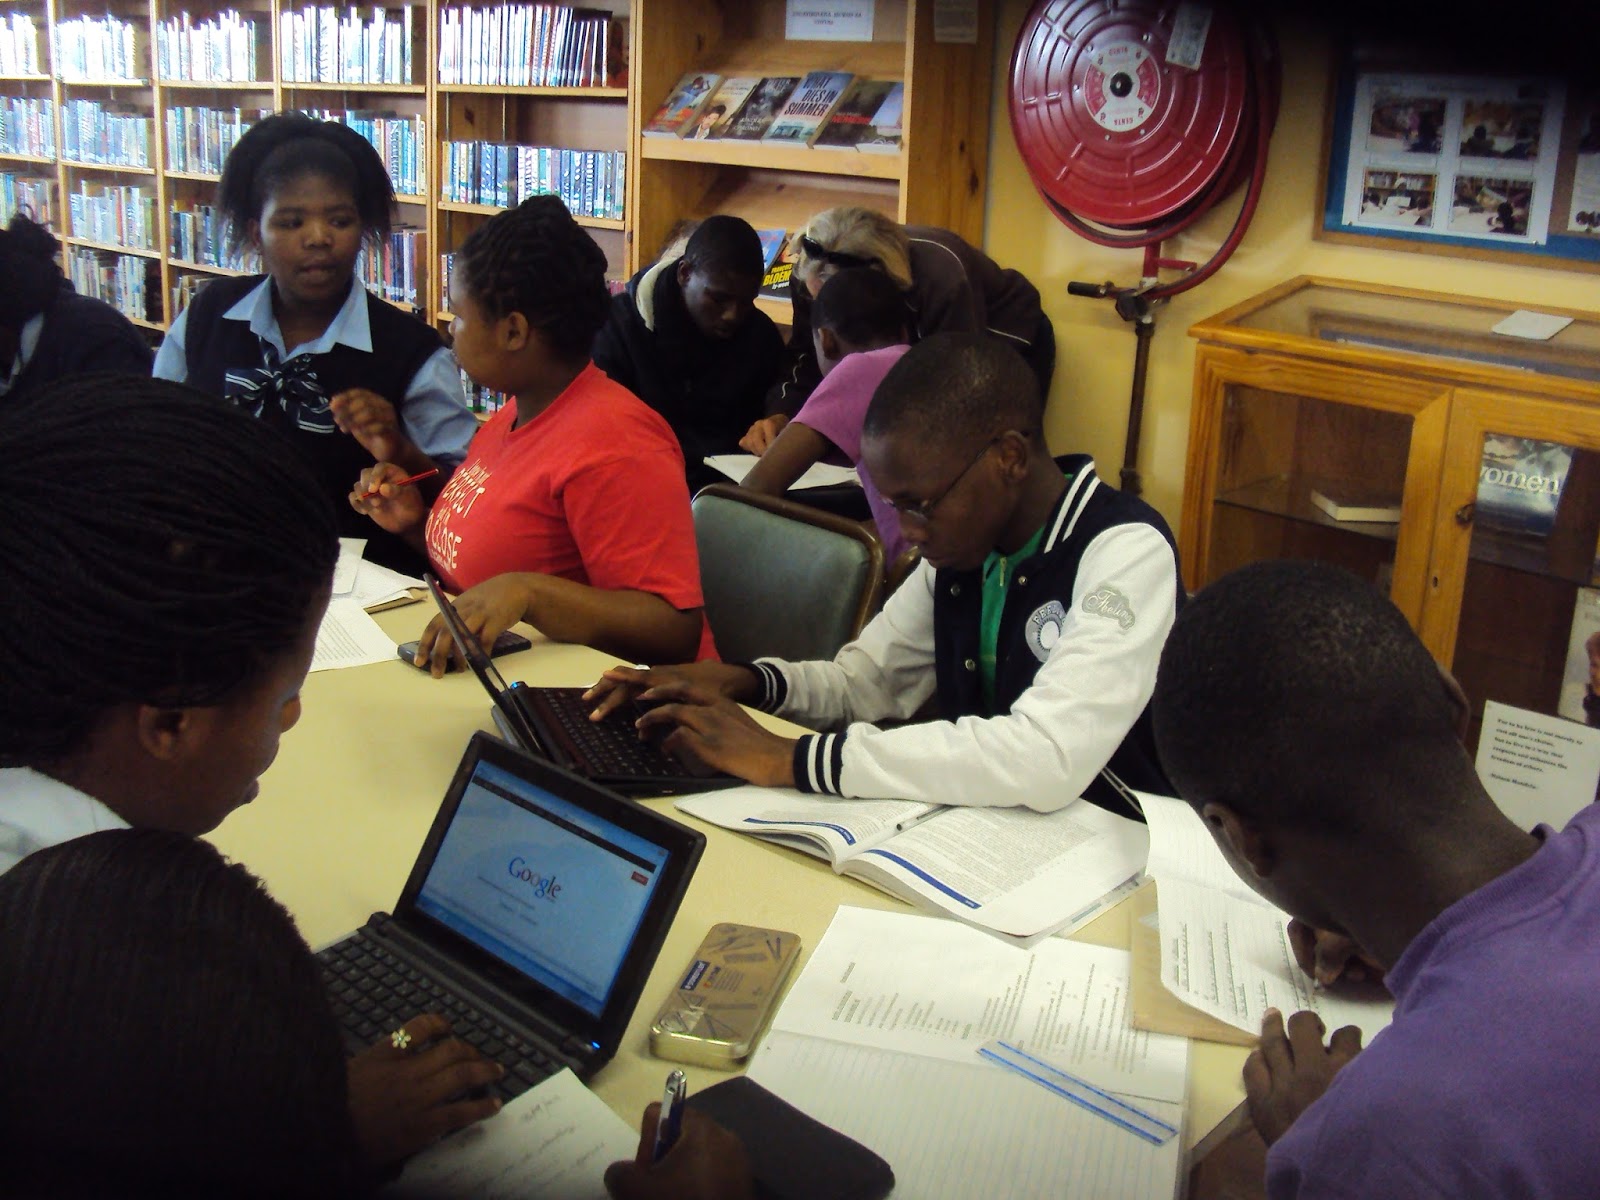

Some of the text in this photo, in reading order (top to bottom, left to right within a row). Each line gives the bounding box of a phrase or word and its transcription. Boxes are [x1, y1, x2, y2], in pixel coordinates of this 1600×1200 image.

[803, 75, 833, 89] WHAT
[801, 90, 839, 104] DIES IN
[784, 102, 830, 117] SUMMER
[508, 856, 562, 899] Google
